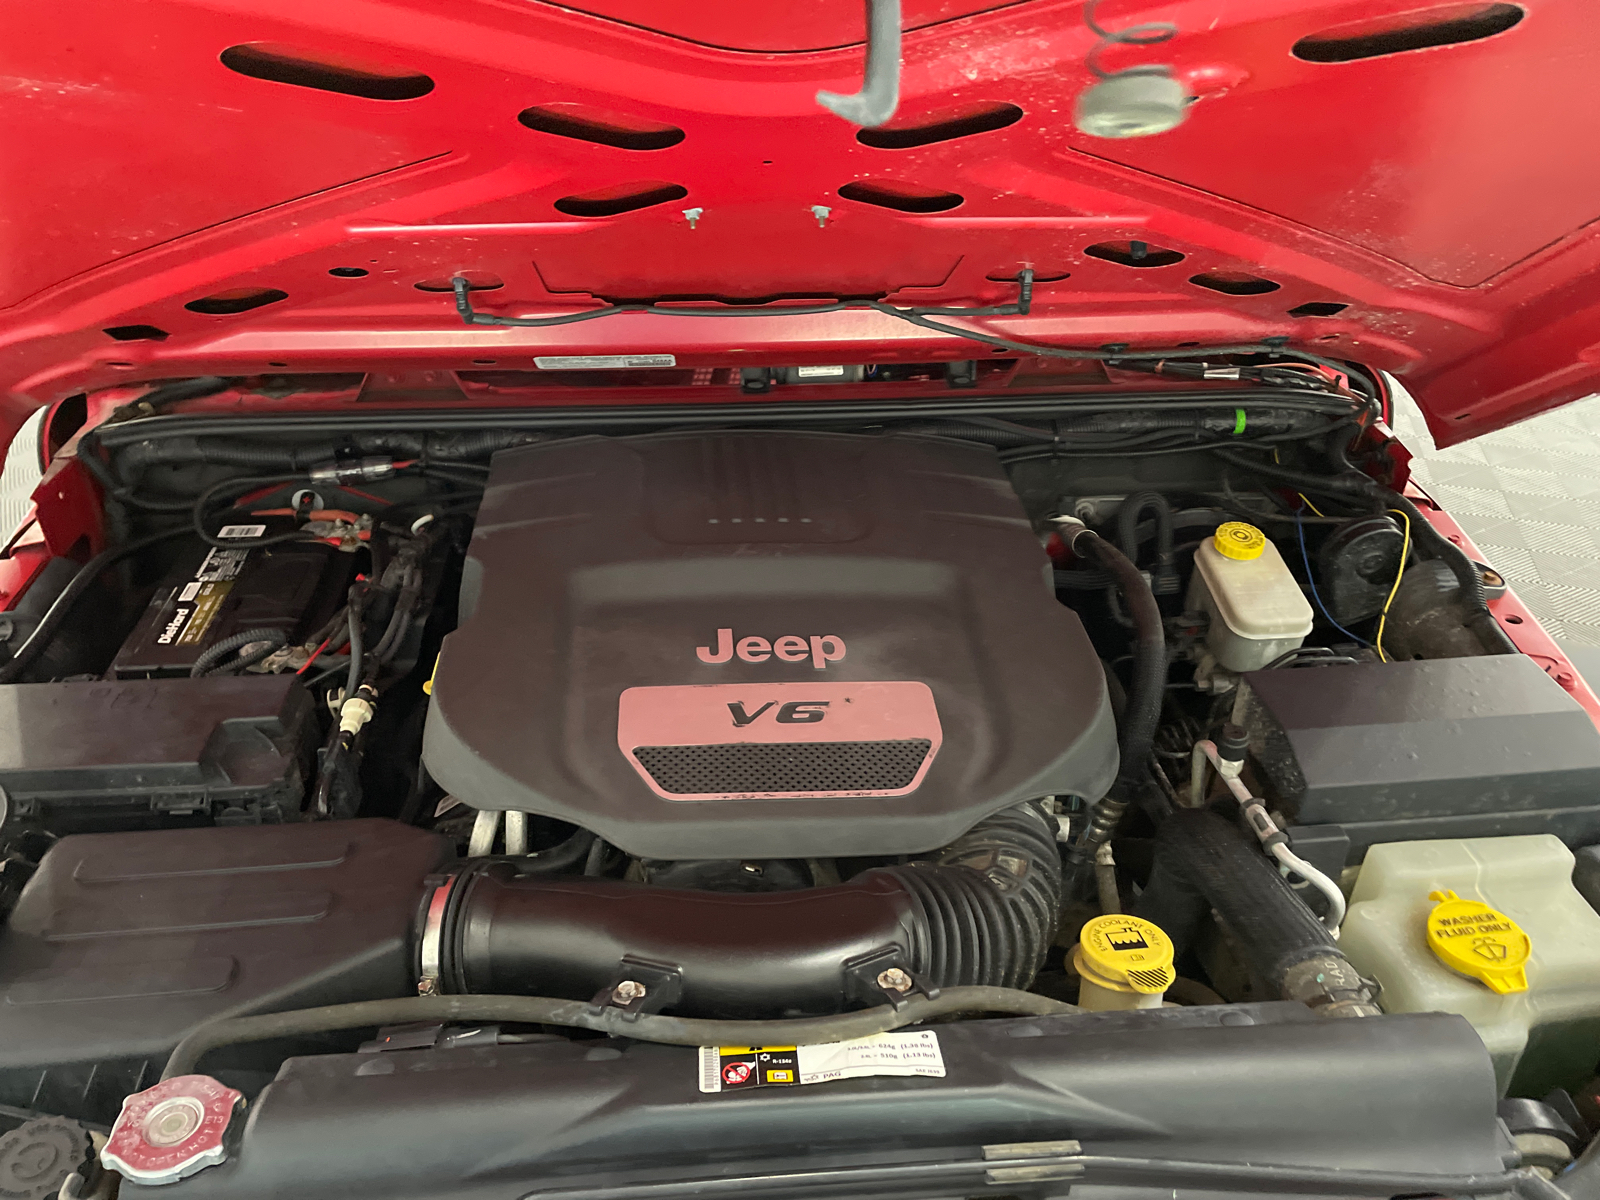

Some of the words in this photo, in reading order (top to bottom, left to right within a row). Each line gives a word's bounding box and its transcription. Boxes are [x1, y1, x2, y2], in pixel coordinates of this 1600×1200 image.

[157, 608, 190, 645] DieHard
[695, 628, 847, 669] Jeep
[726, 700, 831, 727] V6
[1099, 919, 1143, 930] COOLANT
[1435, 927, 1476, 938] FLUID
[1477, 922, 1512, 934] ONLY
[1438, 913, 1497, 926] WASHER
[1091, 928, 1108, 952] ENGINE
[1144, 928, 1161, 947] ONLY
[1324, 961, 1346, 986] RAD
[204, 1115, 224, 1125] E13
[188, 1130, 214, 1152] HOT
